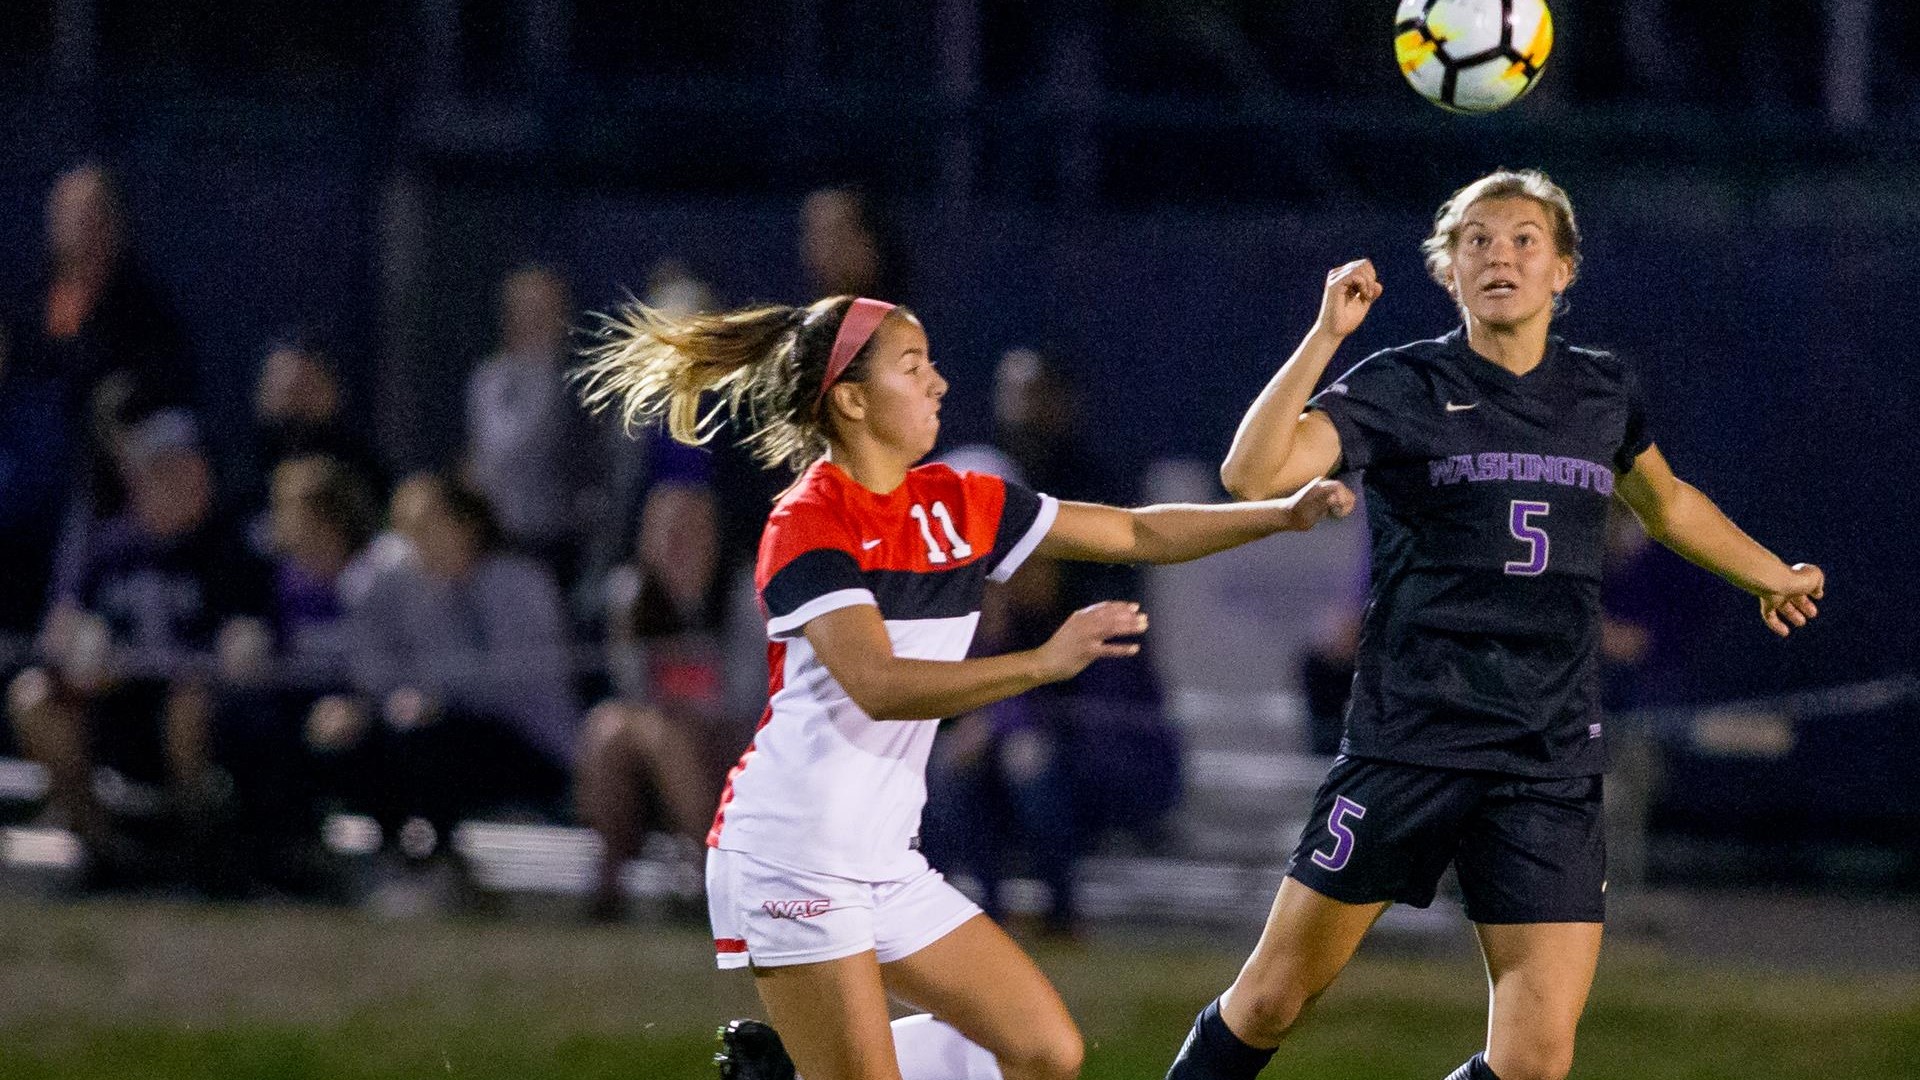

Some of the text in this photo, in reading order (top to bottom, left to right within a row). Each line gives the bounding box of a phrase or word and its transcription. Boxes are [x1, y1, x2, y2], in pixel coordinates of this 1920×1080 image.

[1428, 452, 1615, 496] WASHINGTO
[910, 500, 972, 564] 11
[1504, 500, 1550, 576] 5
[1310, 794, 1367, 872] 5
